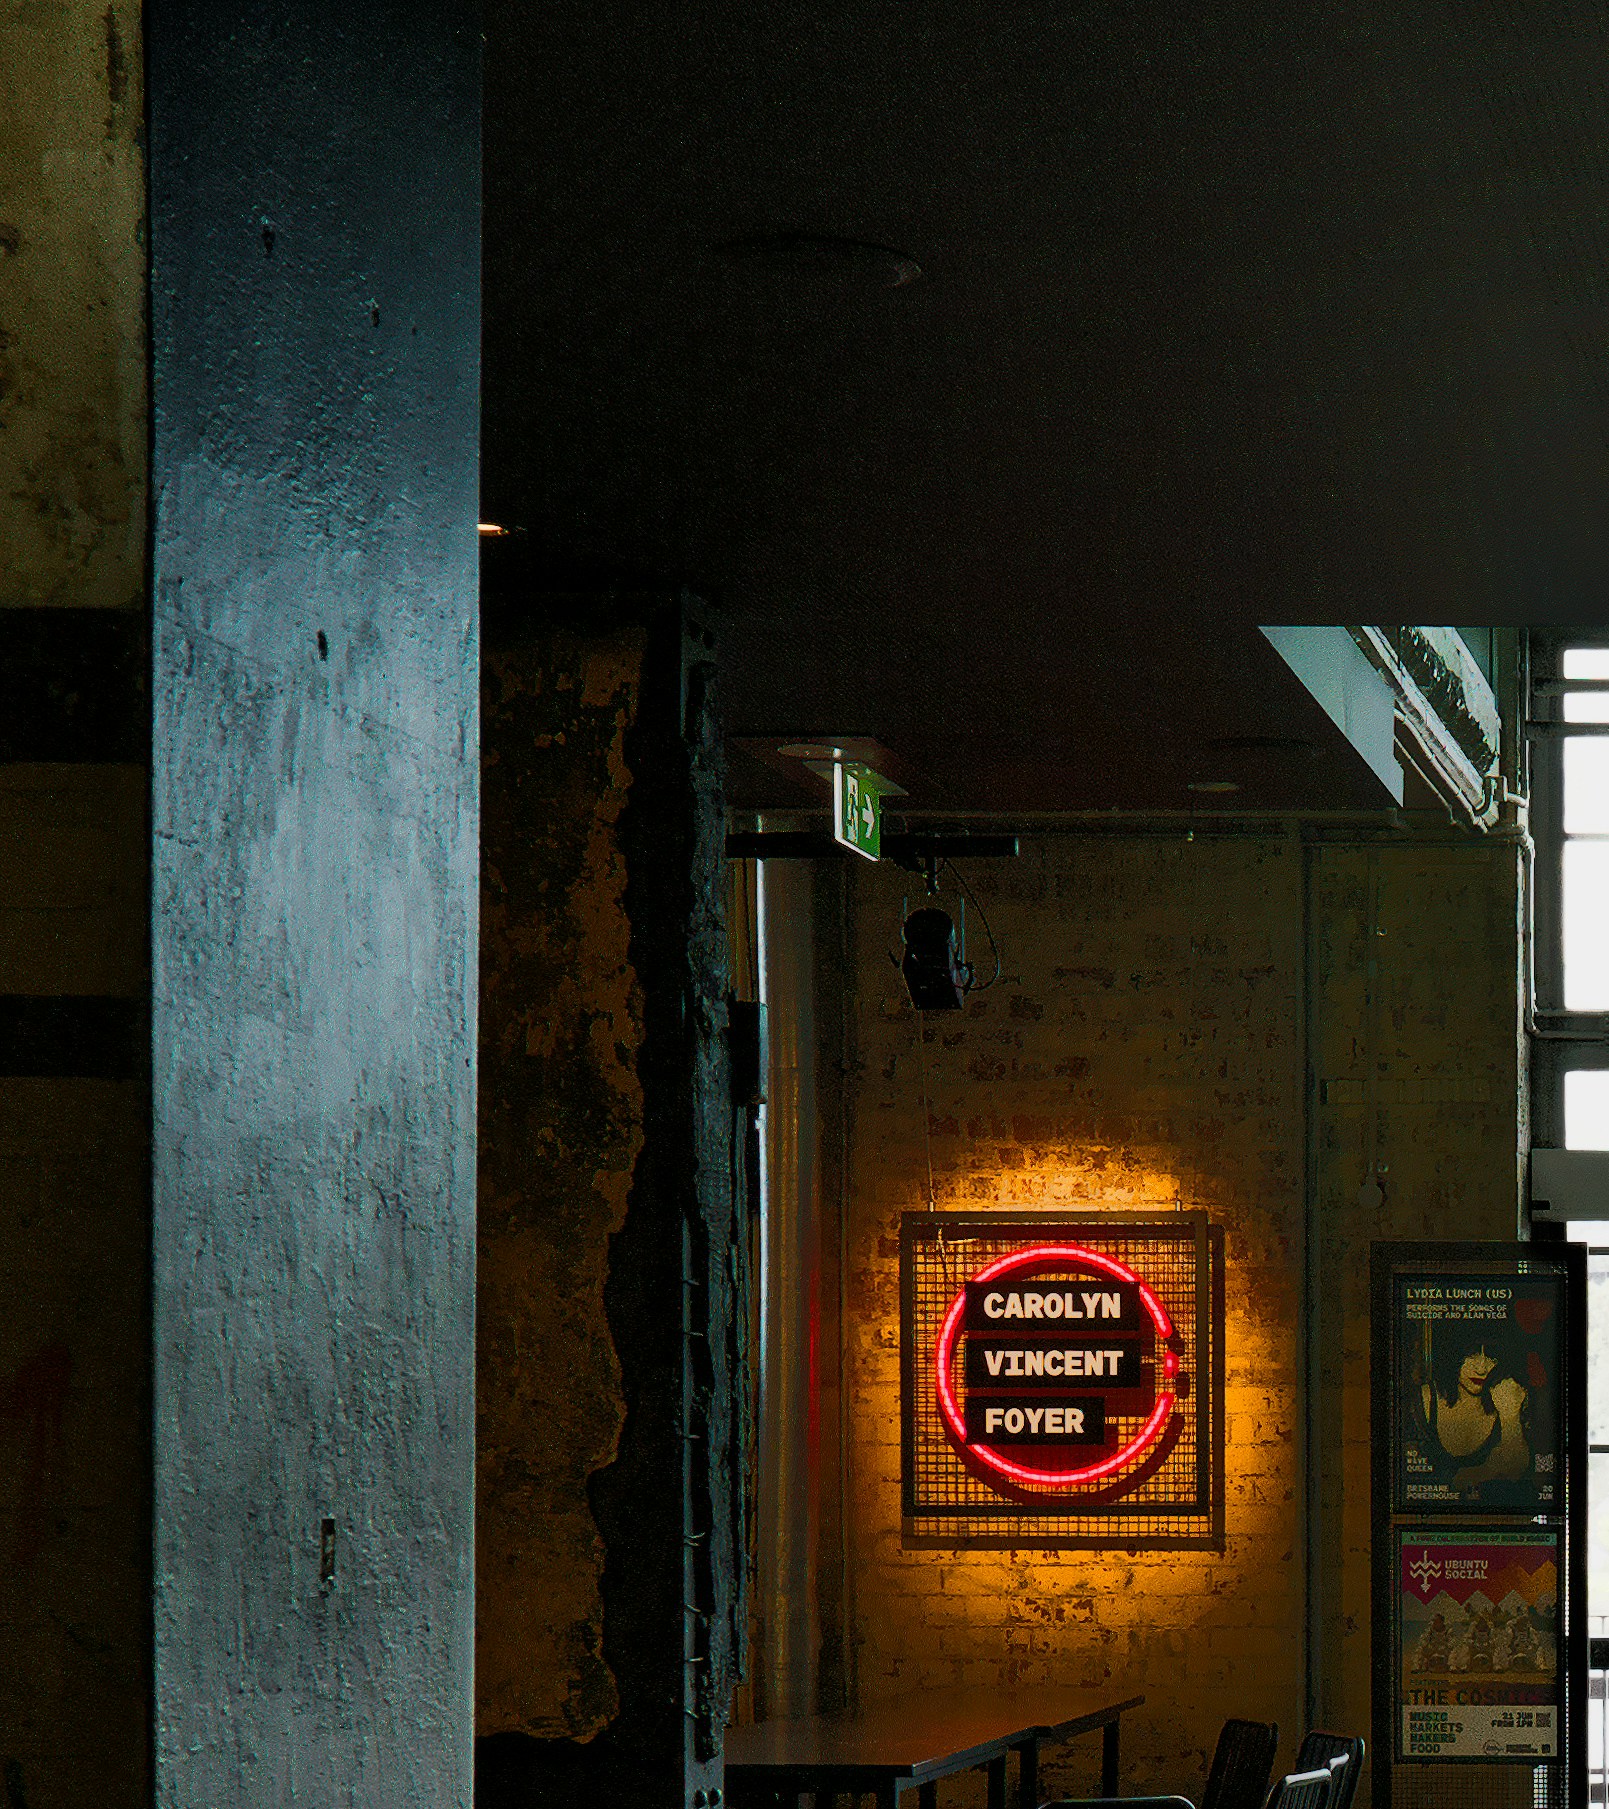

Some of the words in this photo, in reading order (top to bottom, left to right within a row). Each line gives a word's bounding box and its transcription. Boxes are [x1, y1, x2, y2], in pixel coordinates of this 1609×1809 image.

[1406, 1288, 1442, 1299] LYDIA
[1446, 1288, 1481, 1299] LUNCH
[1486, 1288, 1513, 1300] (US)
[983, 1293, 1121, 1319] CAROLYN
[1451, 1304, 1466, 1312] THE
[1468, 1304, 1494, 1312] SONGS
[984, 1350, 1124, 1376] VINCENT
[985, 1408, 1084, 1433] FOYER
[1444, 1560, 1488, 1569] UBUNTU
[1444, 1570, 1488, 1579] SOCIAL
[1409, 1689, 1448, 1705] THE
[1409, 1712, 1448, 1721] MUSIC
[1409, 1722, 1463, 1732] MARKETS
[1409, 1733, 1456, 1743] MAKERS
[1409, 1743, 1441, 1753] FOOD
